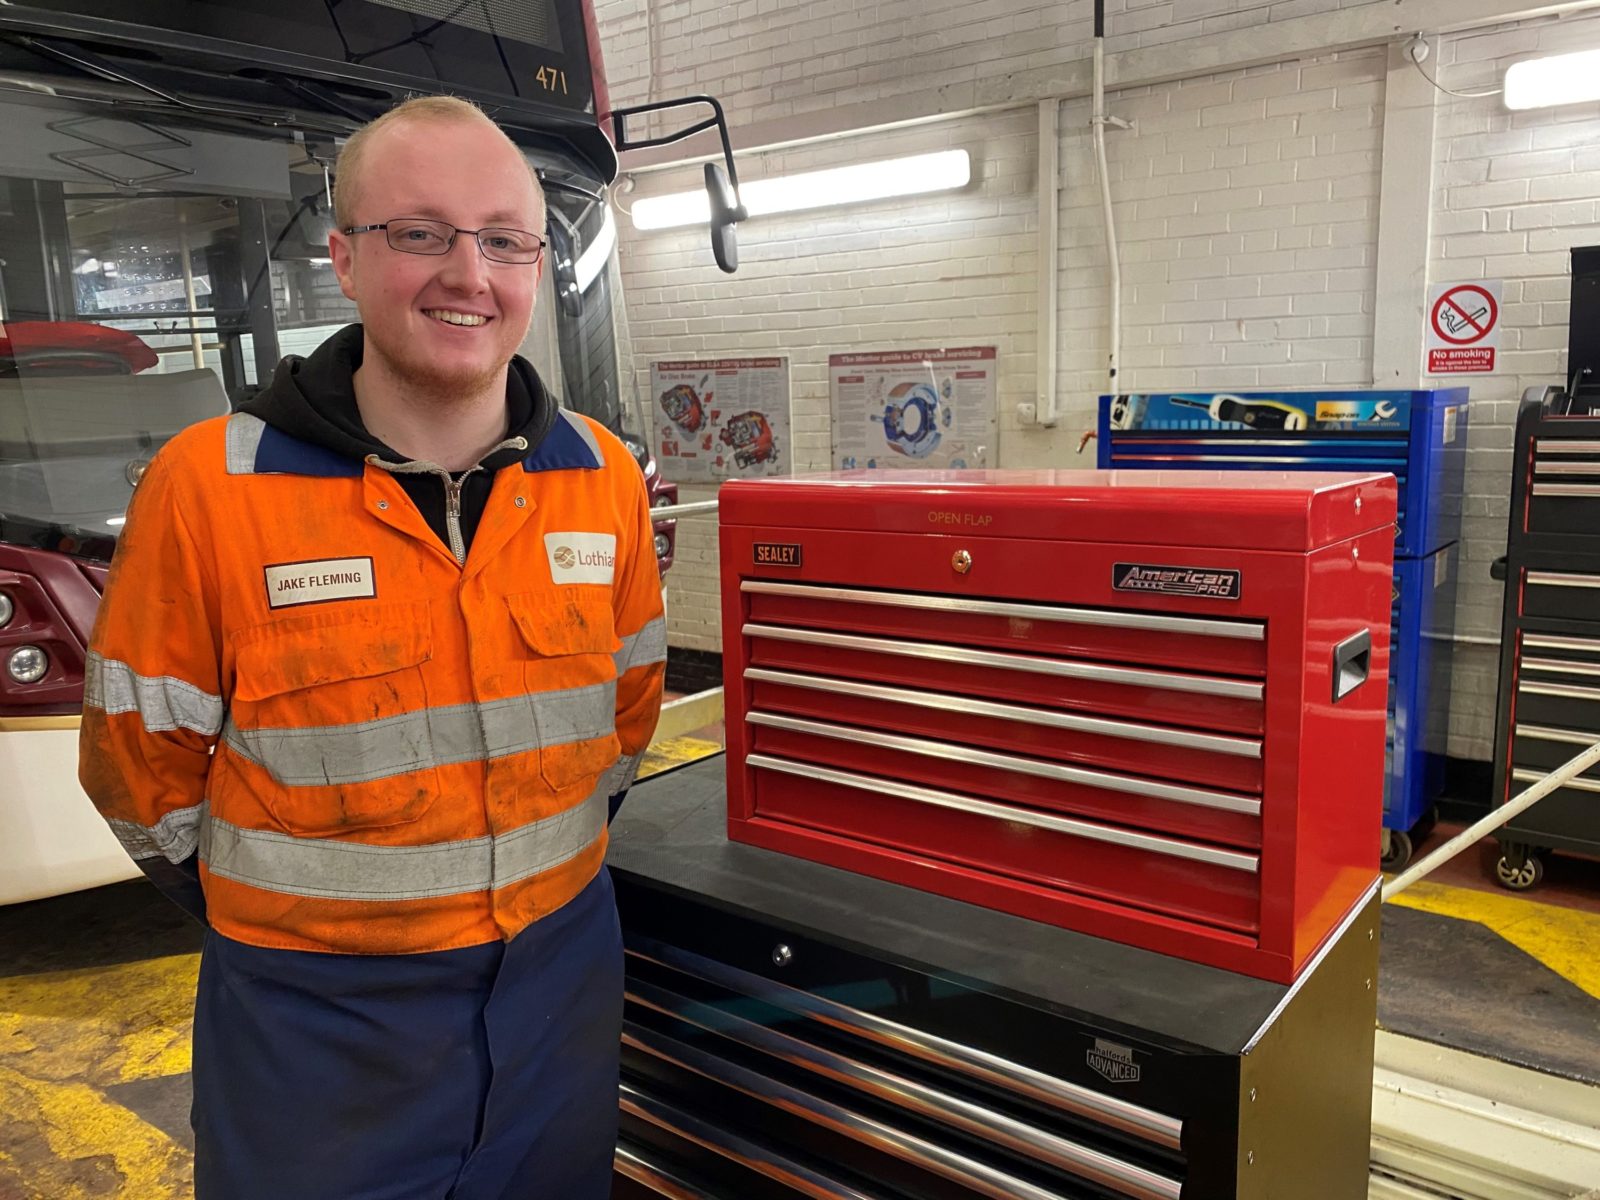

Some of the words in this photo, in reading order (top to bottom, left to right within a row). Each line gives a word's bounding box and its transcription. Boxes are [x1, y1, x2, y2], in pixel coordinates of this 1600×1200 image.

[535, 65, 568, 95] 471
[841, 355, 854, 363] The
[882, 353, 901, 363] guide
[912, 352, 923, 360] CV
[1432, 351, 1447, 359] No
[1449, 349, 1491, 359] smoking
[927, 511, 961, 524] OPEN
[964, 514, 993, 527] FLAP
[758, 546, 795, 562] SEALEY
[277, 577, 306, 592] JAKE
[309, 572, 361, 587] FLEMING
[1119, 566, 1234, 588] American
[1197, 584, 1231, 595] PRO
[1095, 1046, 1131, 1064] halfords
[1089, 1054, 1137, 1079] ADVANCED
